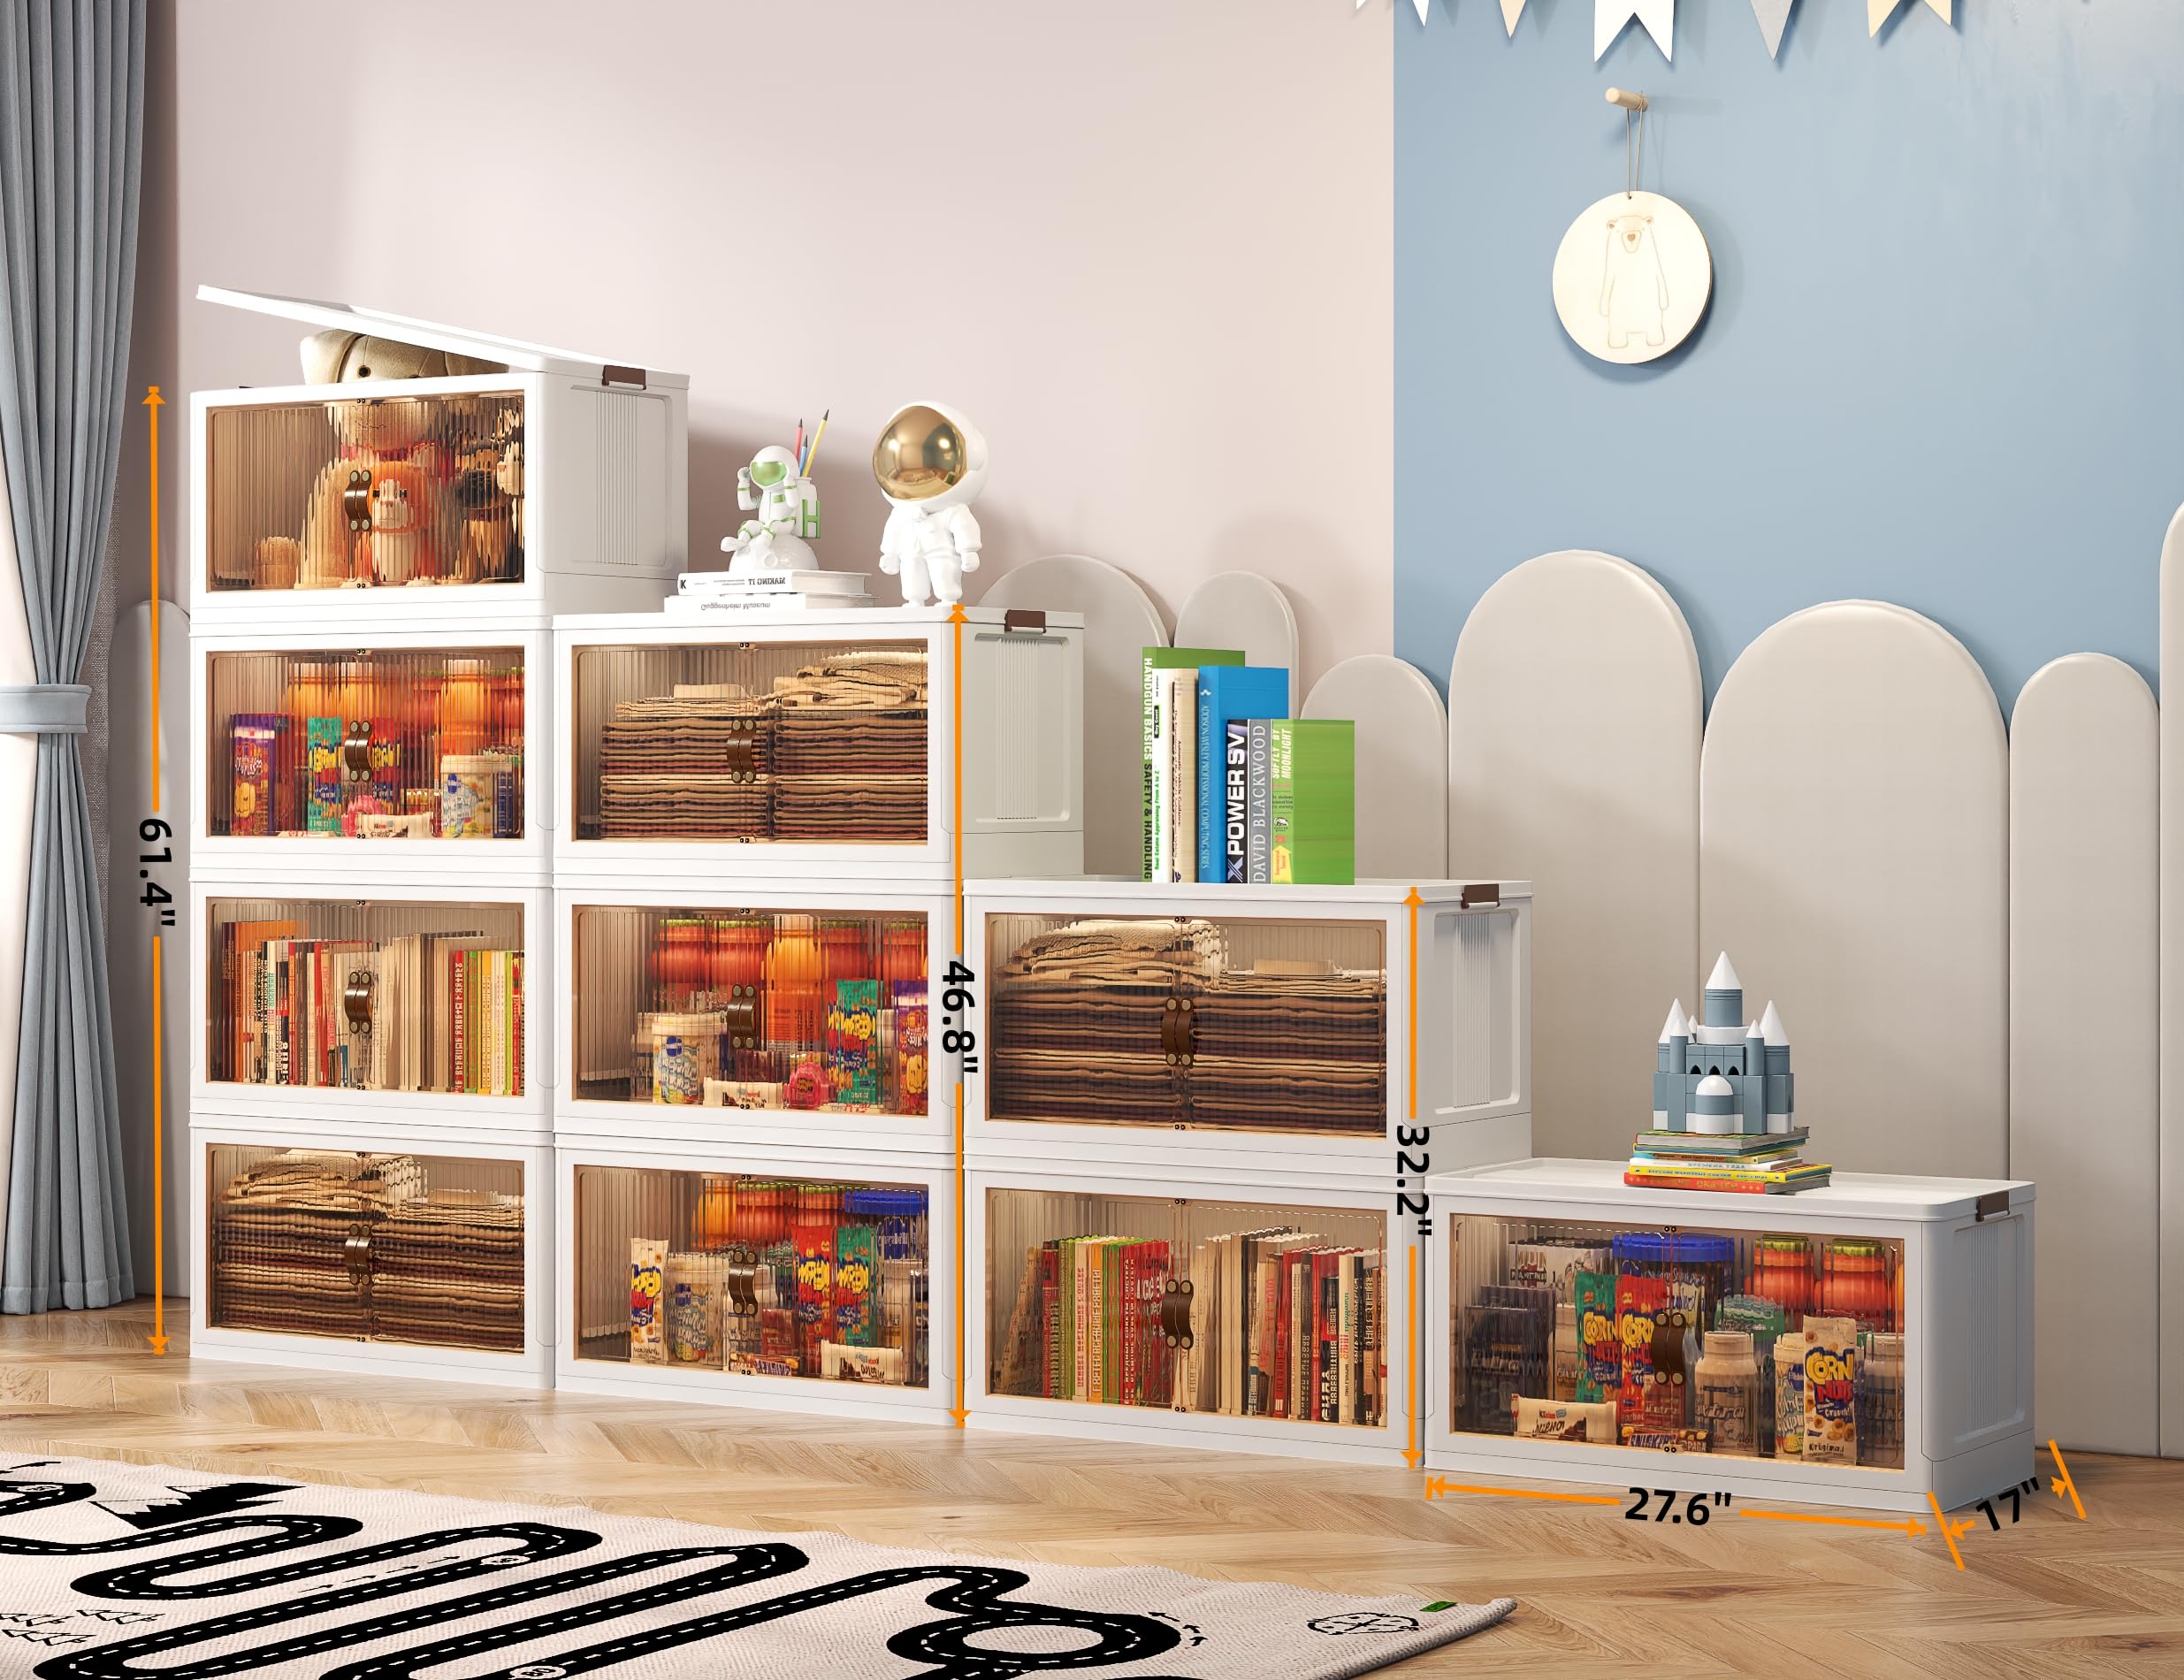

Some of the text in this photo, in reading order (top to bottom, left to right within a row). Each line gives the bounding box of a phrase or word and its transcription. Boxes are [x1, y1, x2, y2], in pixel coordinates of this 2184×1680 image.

[1273, 729, 1280, 741] BY
[1281, 729, 1292, 779] MOONLIGHT
[1201, 761, 1210, 806] PROFESSIONAL
[1144, 807, 1152, 817] &
[1253, 725, 1266, 882] DAVID BLACKWOOD
[1201, 808, 1210, 848] COMPUTING
[1201, 849, 1210, 869] SERIES
[1806, 1351, 1855, 1386] CORN
